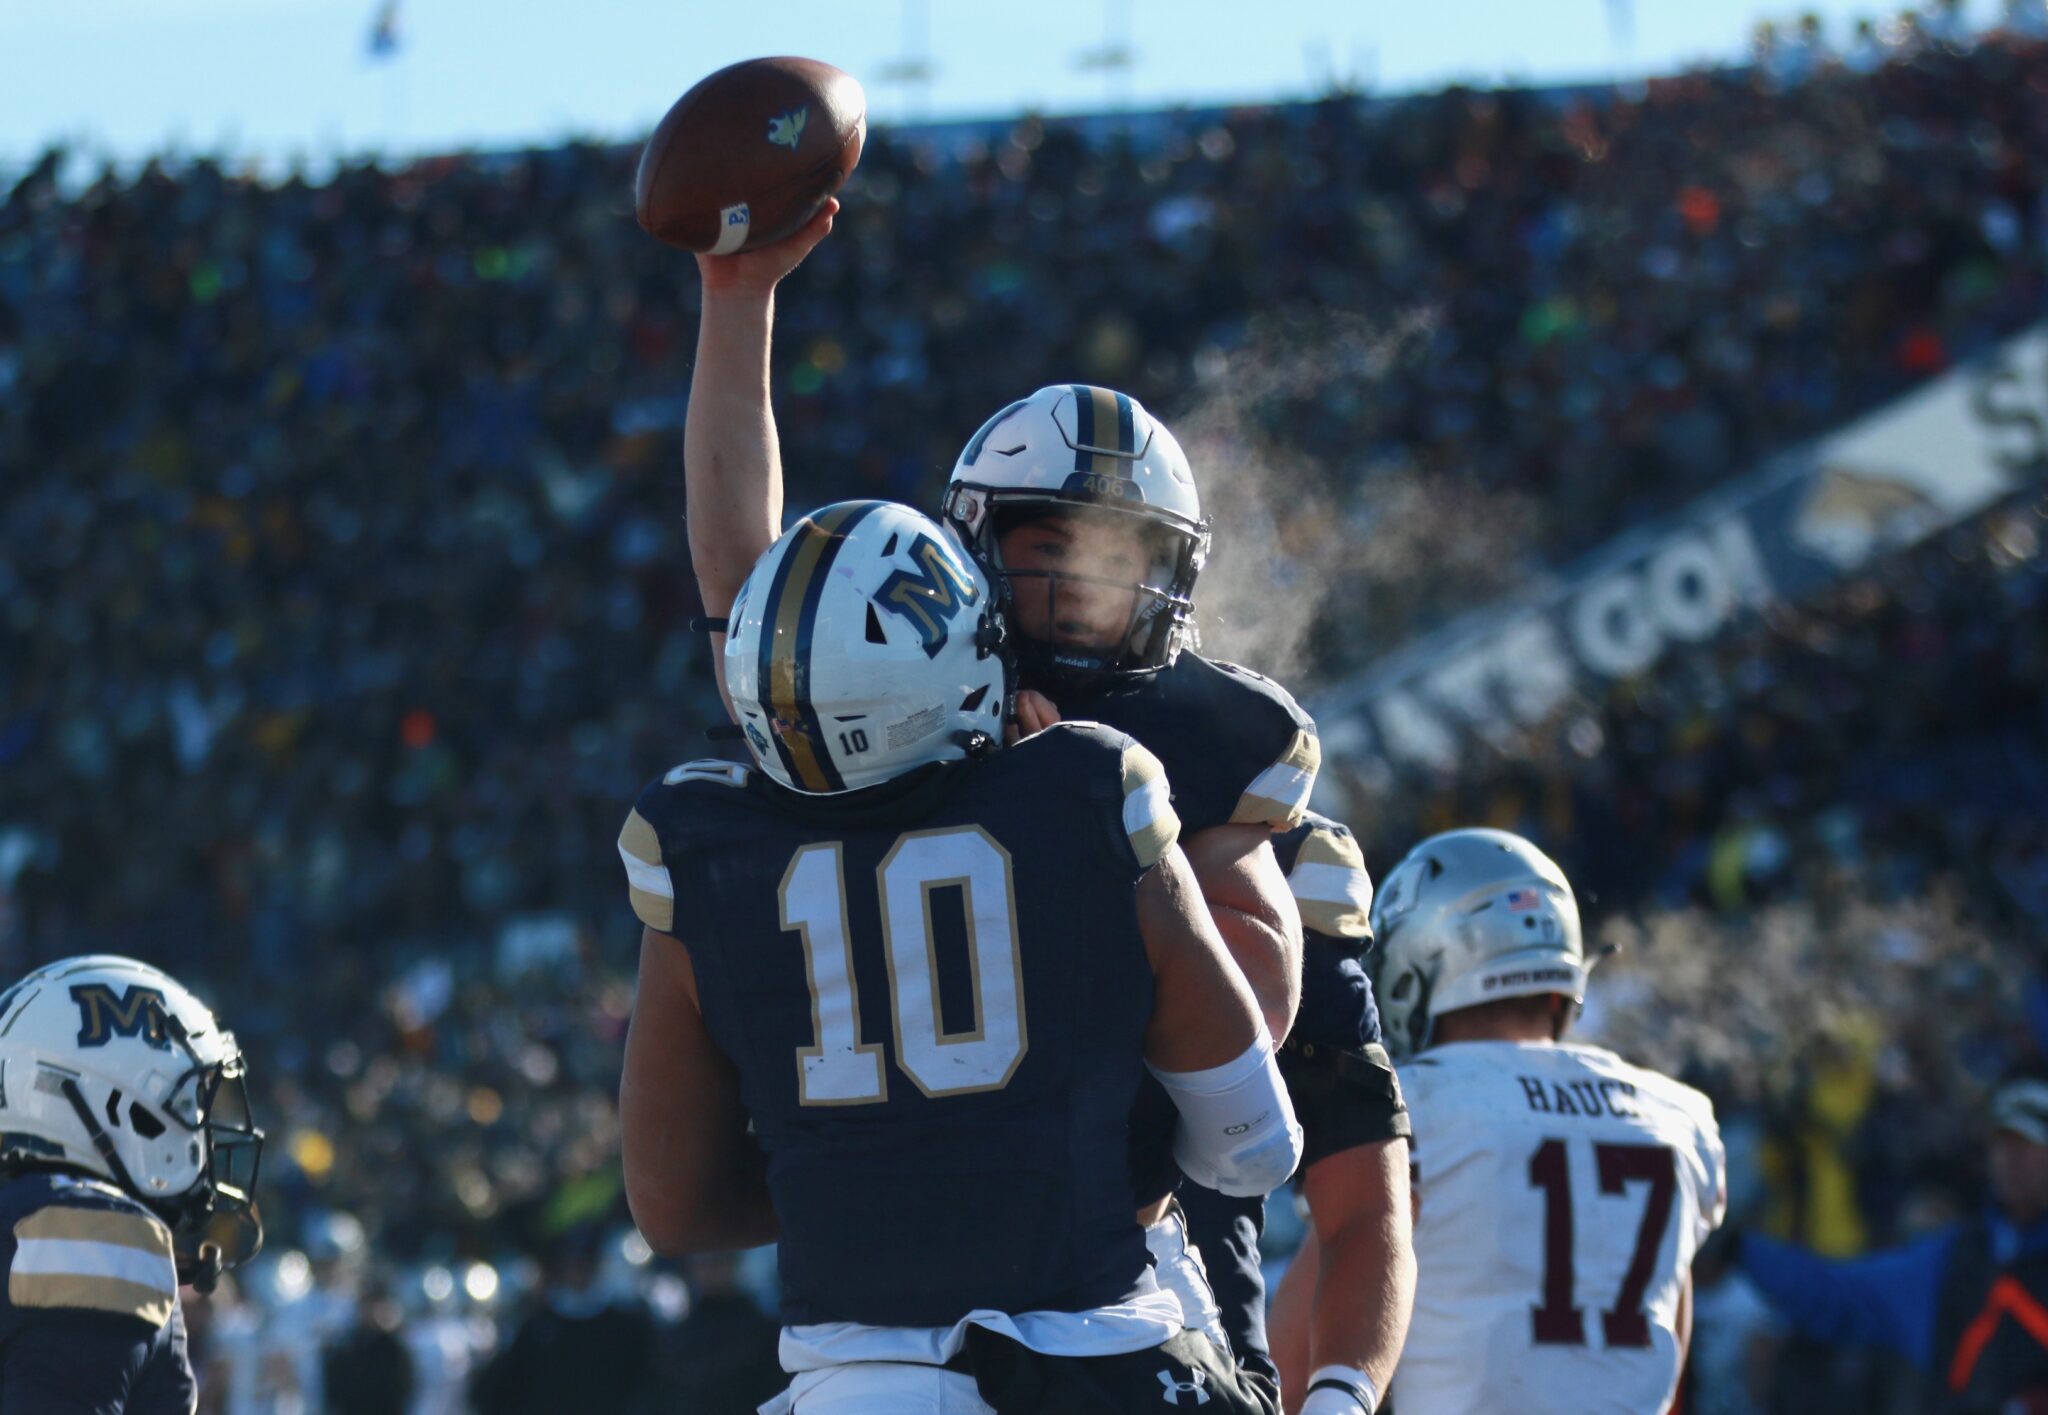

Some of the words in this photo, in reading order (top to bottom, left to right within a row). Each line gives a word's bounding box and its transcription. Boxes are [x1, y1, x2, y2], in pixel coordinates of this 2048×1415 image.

[1083, 475, 1124, 497] 406
[872, 531, 980, 660] M
[839, 728, 869, 756] 10
[777, 824, 1028, 1106] 10
[69, 983, 171, 1053] M
[1529, 1138, 1677, 1347] 17
